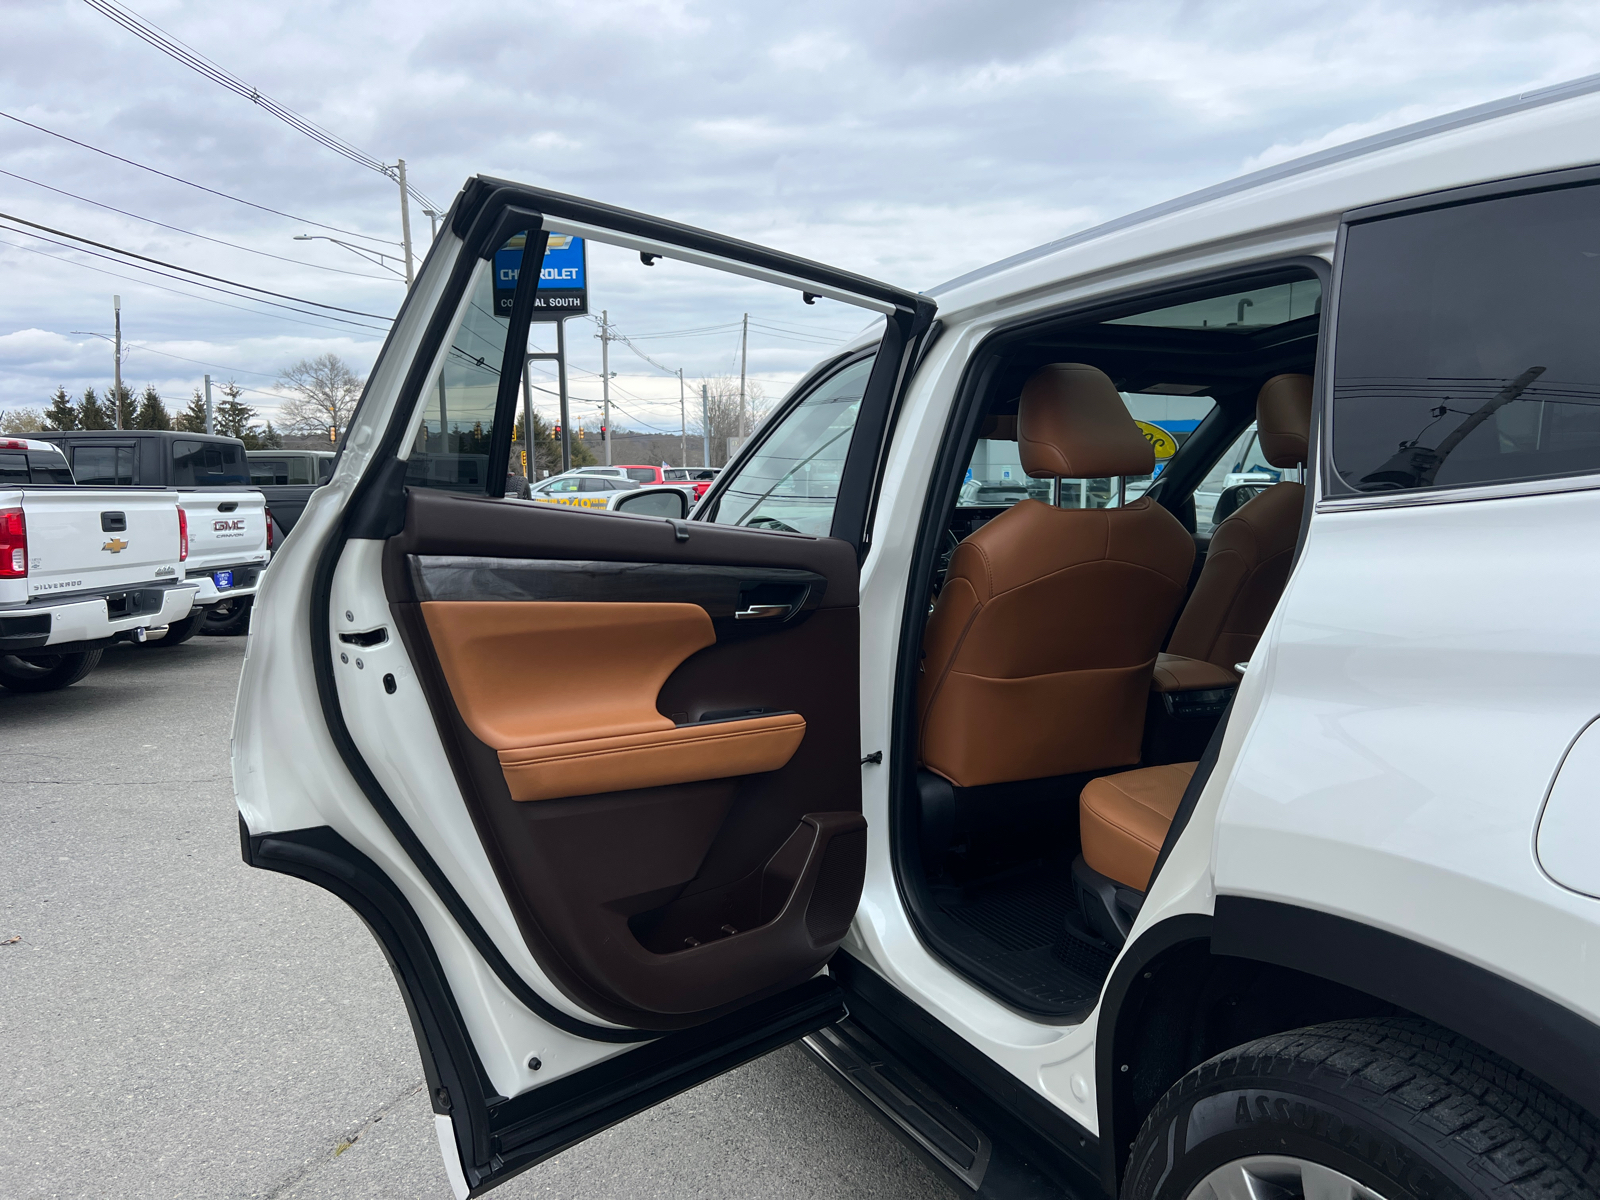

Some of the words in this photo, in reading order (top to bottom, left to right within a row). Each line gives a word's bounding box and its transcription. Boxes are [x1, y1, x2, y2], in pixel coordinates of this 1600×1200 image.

[549, 297, 581, 307] SOUTH
[214, 520, 245, 531] GMC
[33, 580, 82, 591] SILVERADO
[1235, 1095, 1449, 1200] ASSURANC
